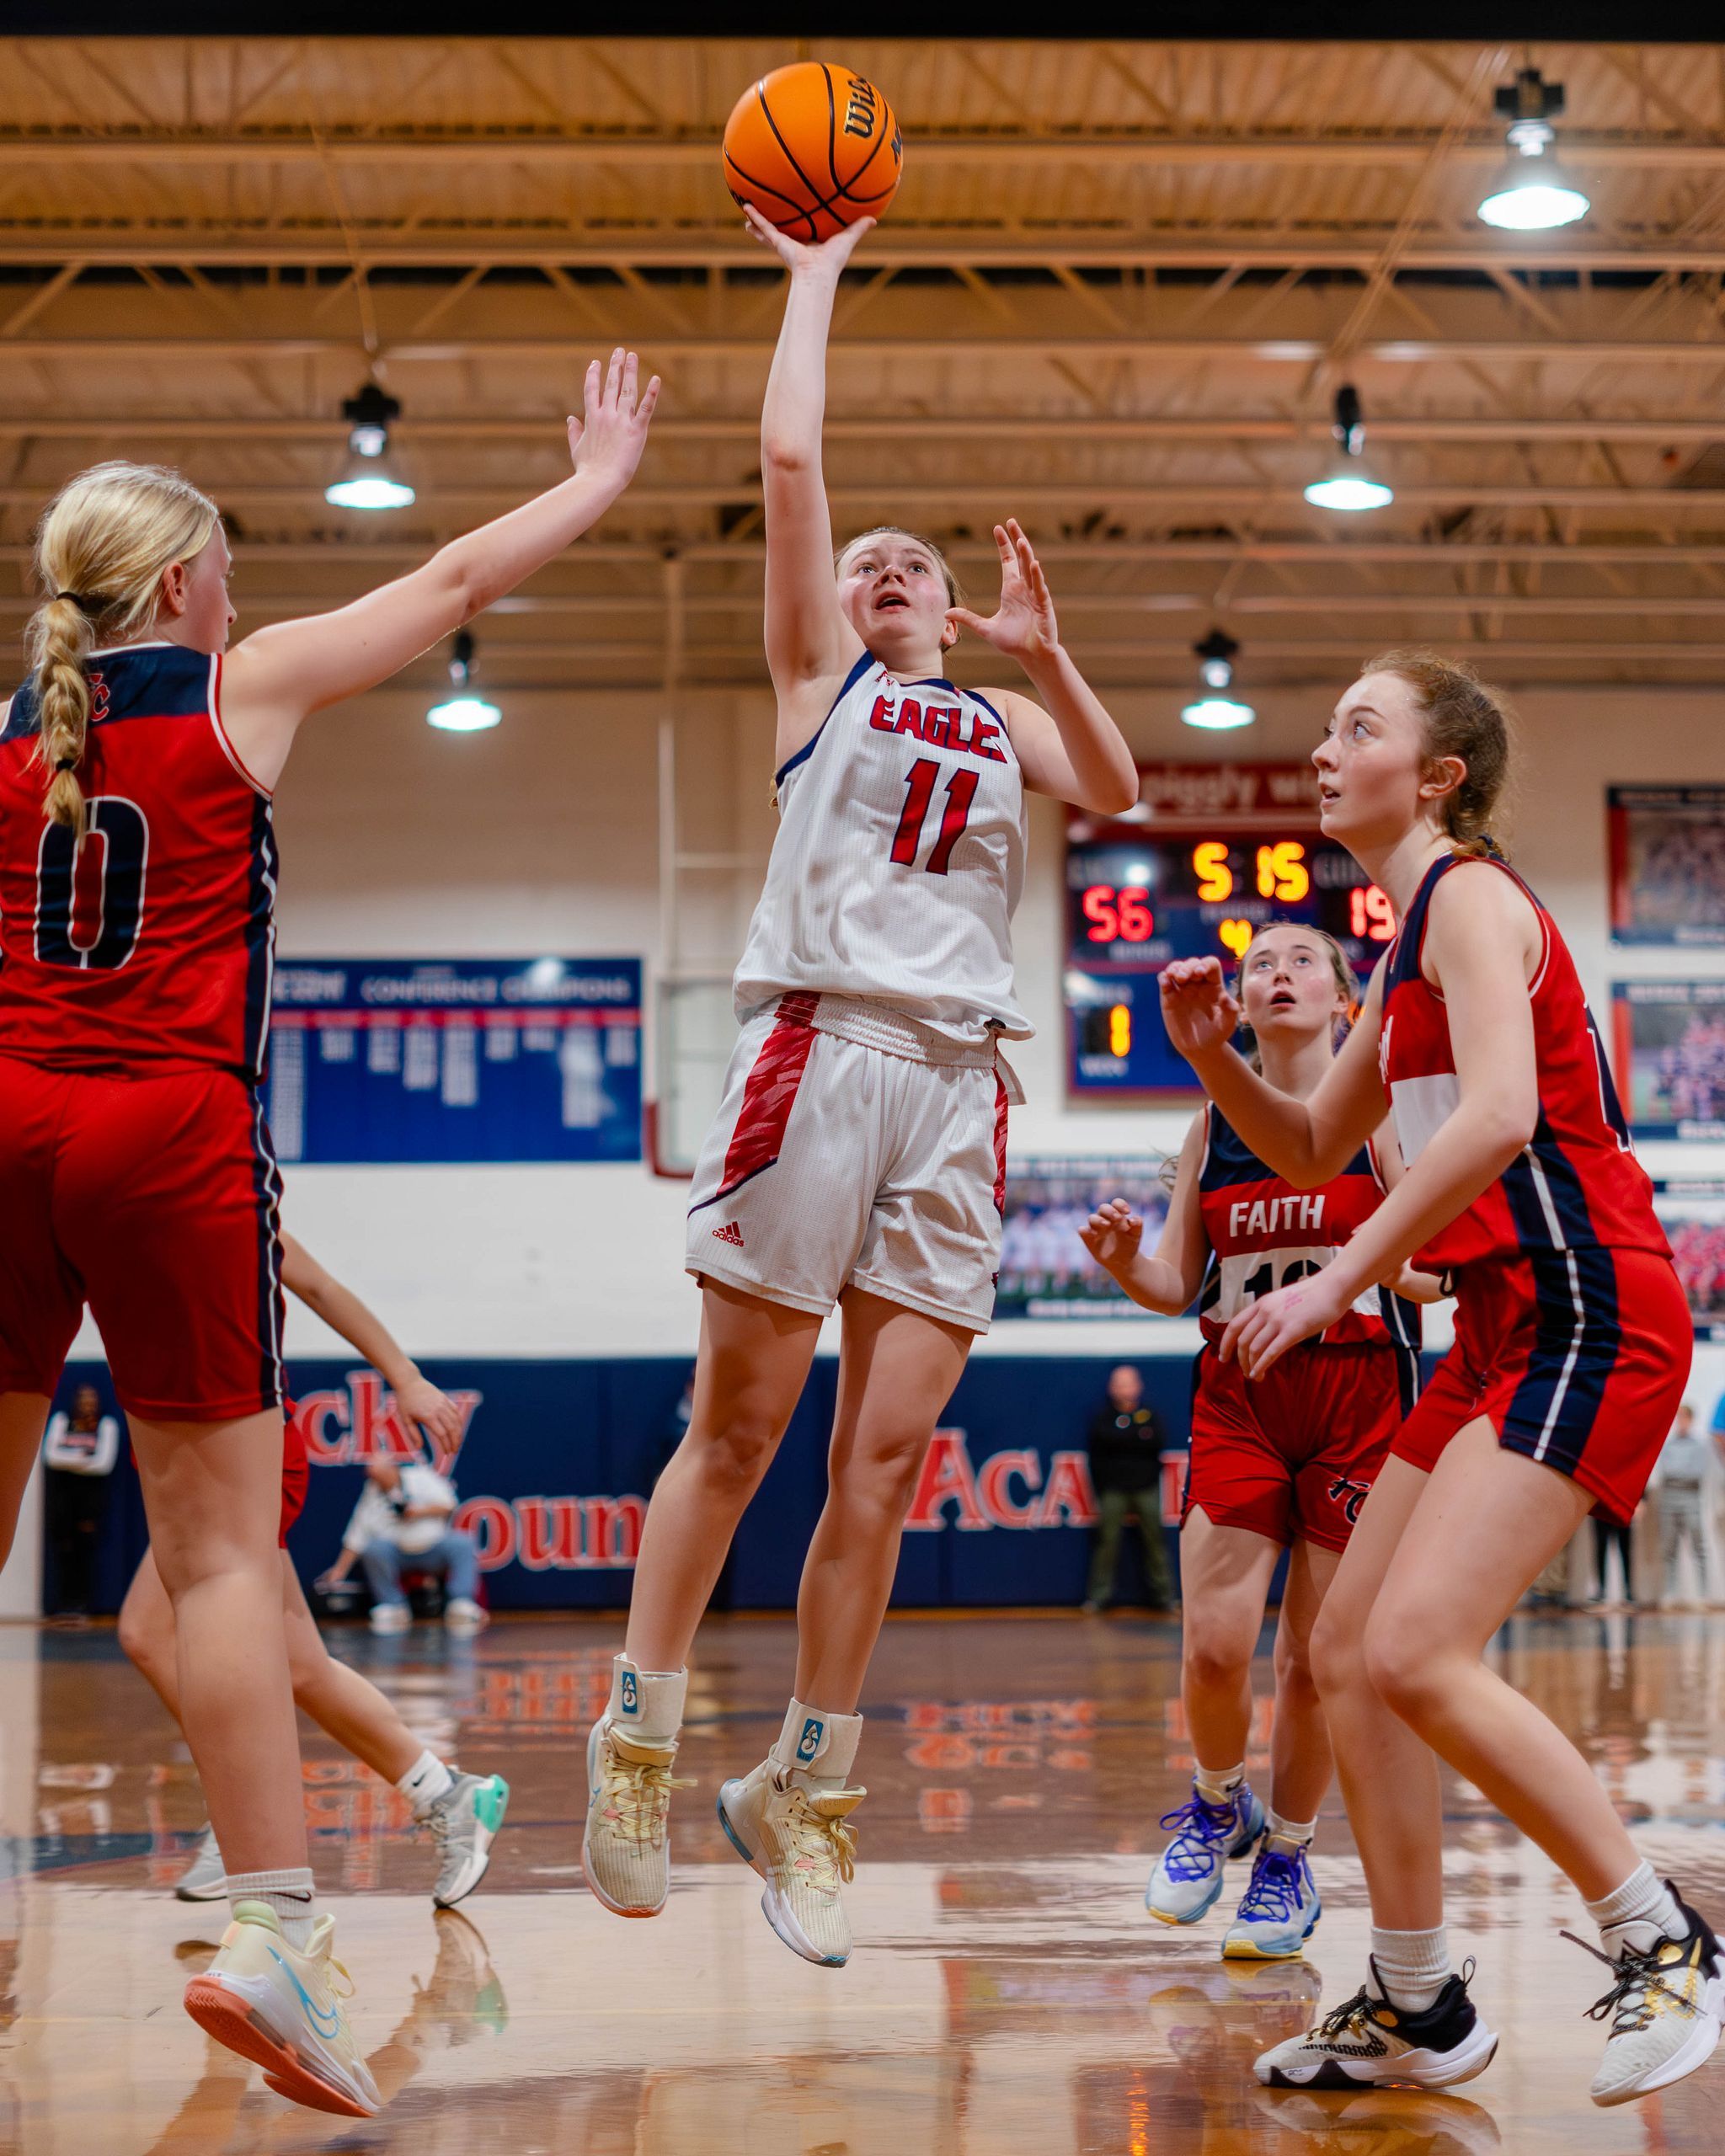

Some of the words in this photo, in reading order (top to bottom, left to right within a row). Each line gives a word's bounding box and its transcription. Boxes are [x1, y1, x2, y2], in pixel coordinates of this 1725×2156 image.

[889, 758, 980, 877] 11
[0, 795, 149, 970] 0
[1257, 841, 1310, 902] 15
[1082, 884, 1154, 942] 56
[1350, 884, 1397, 941] 19
[1109, 1003, 1131, 1058] 1
[712, 1230, 745, 1247] adidas
[1229, 1194, 1326, 1238] FAITH
[295, 1369, 483, 1478] cky
[452, 1495, 649, 1572] oun
